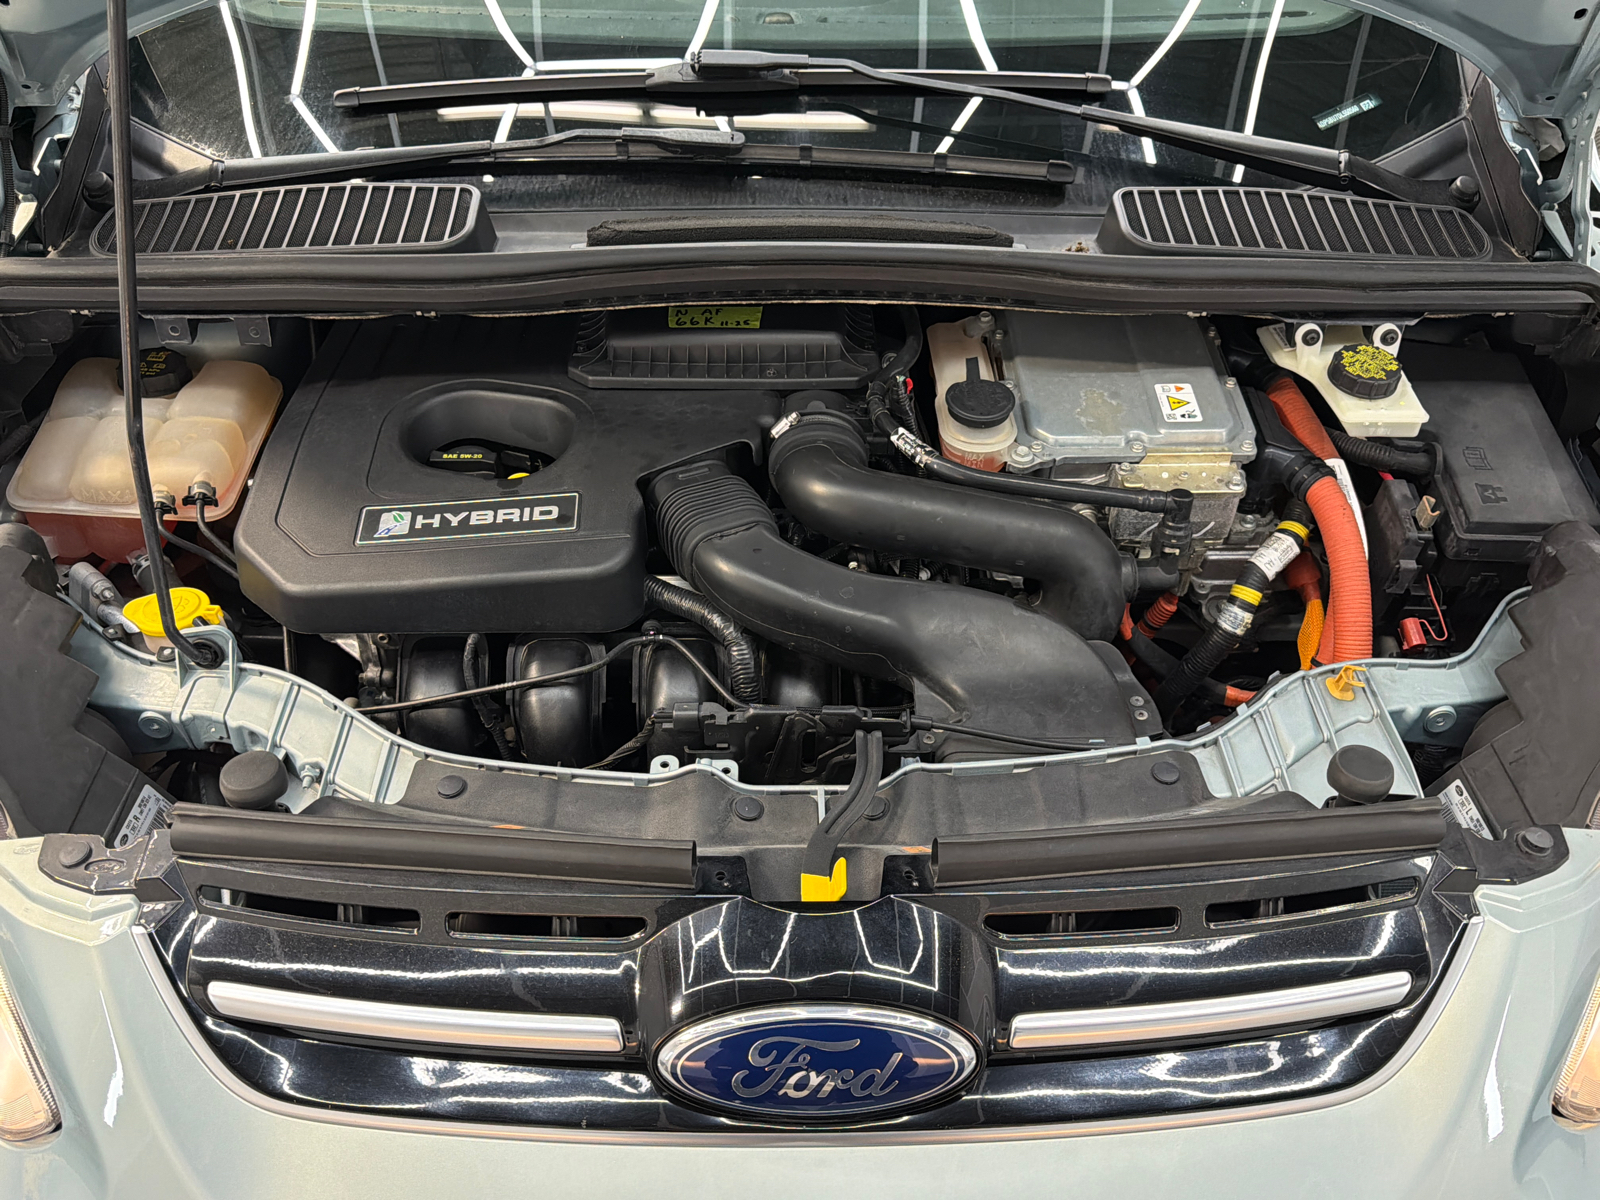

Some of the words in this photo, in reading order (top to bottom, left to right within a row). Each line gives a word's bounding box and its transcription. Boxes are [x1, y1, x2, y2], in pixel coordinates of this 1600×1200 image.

[675, 309, 688, 317] N
[675, 316, 714, 326] 66K
[965, 452, 985, 461] MAX
[964, 459, 984, 468] MIN
[415, 505, 560, 529] HYBRID
[133, 814, 141, 823] R
[731, 1035, 905, 1099] Ford
